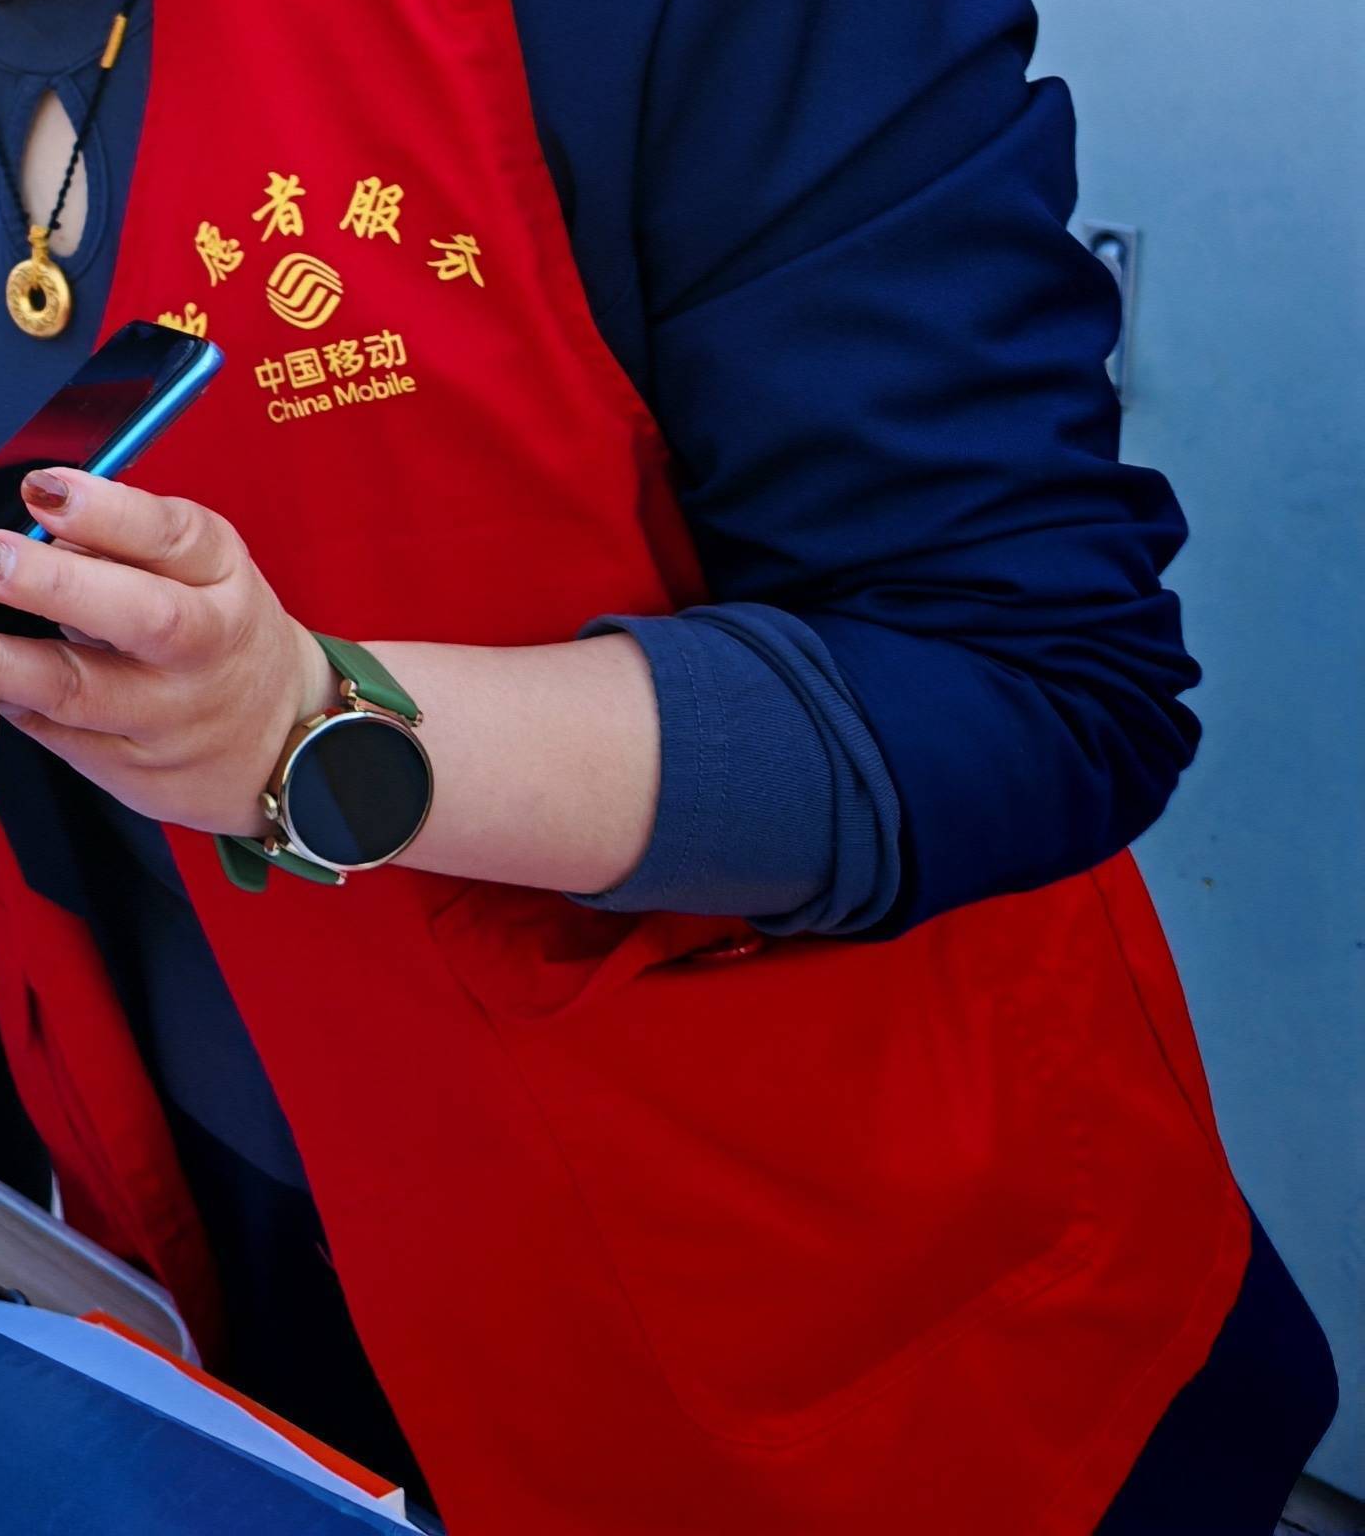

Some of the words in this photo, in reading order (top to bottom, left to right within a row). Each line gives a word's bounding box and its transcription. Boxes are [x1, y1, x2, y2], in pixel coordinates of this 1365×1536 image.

[254, 329, 407, 395] 中国移动
[267, 389, 333, 424] China
[333, 372, 417, 407] Mobile
